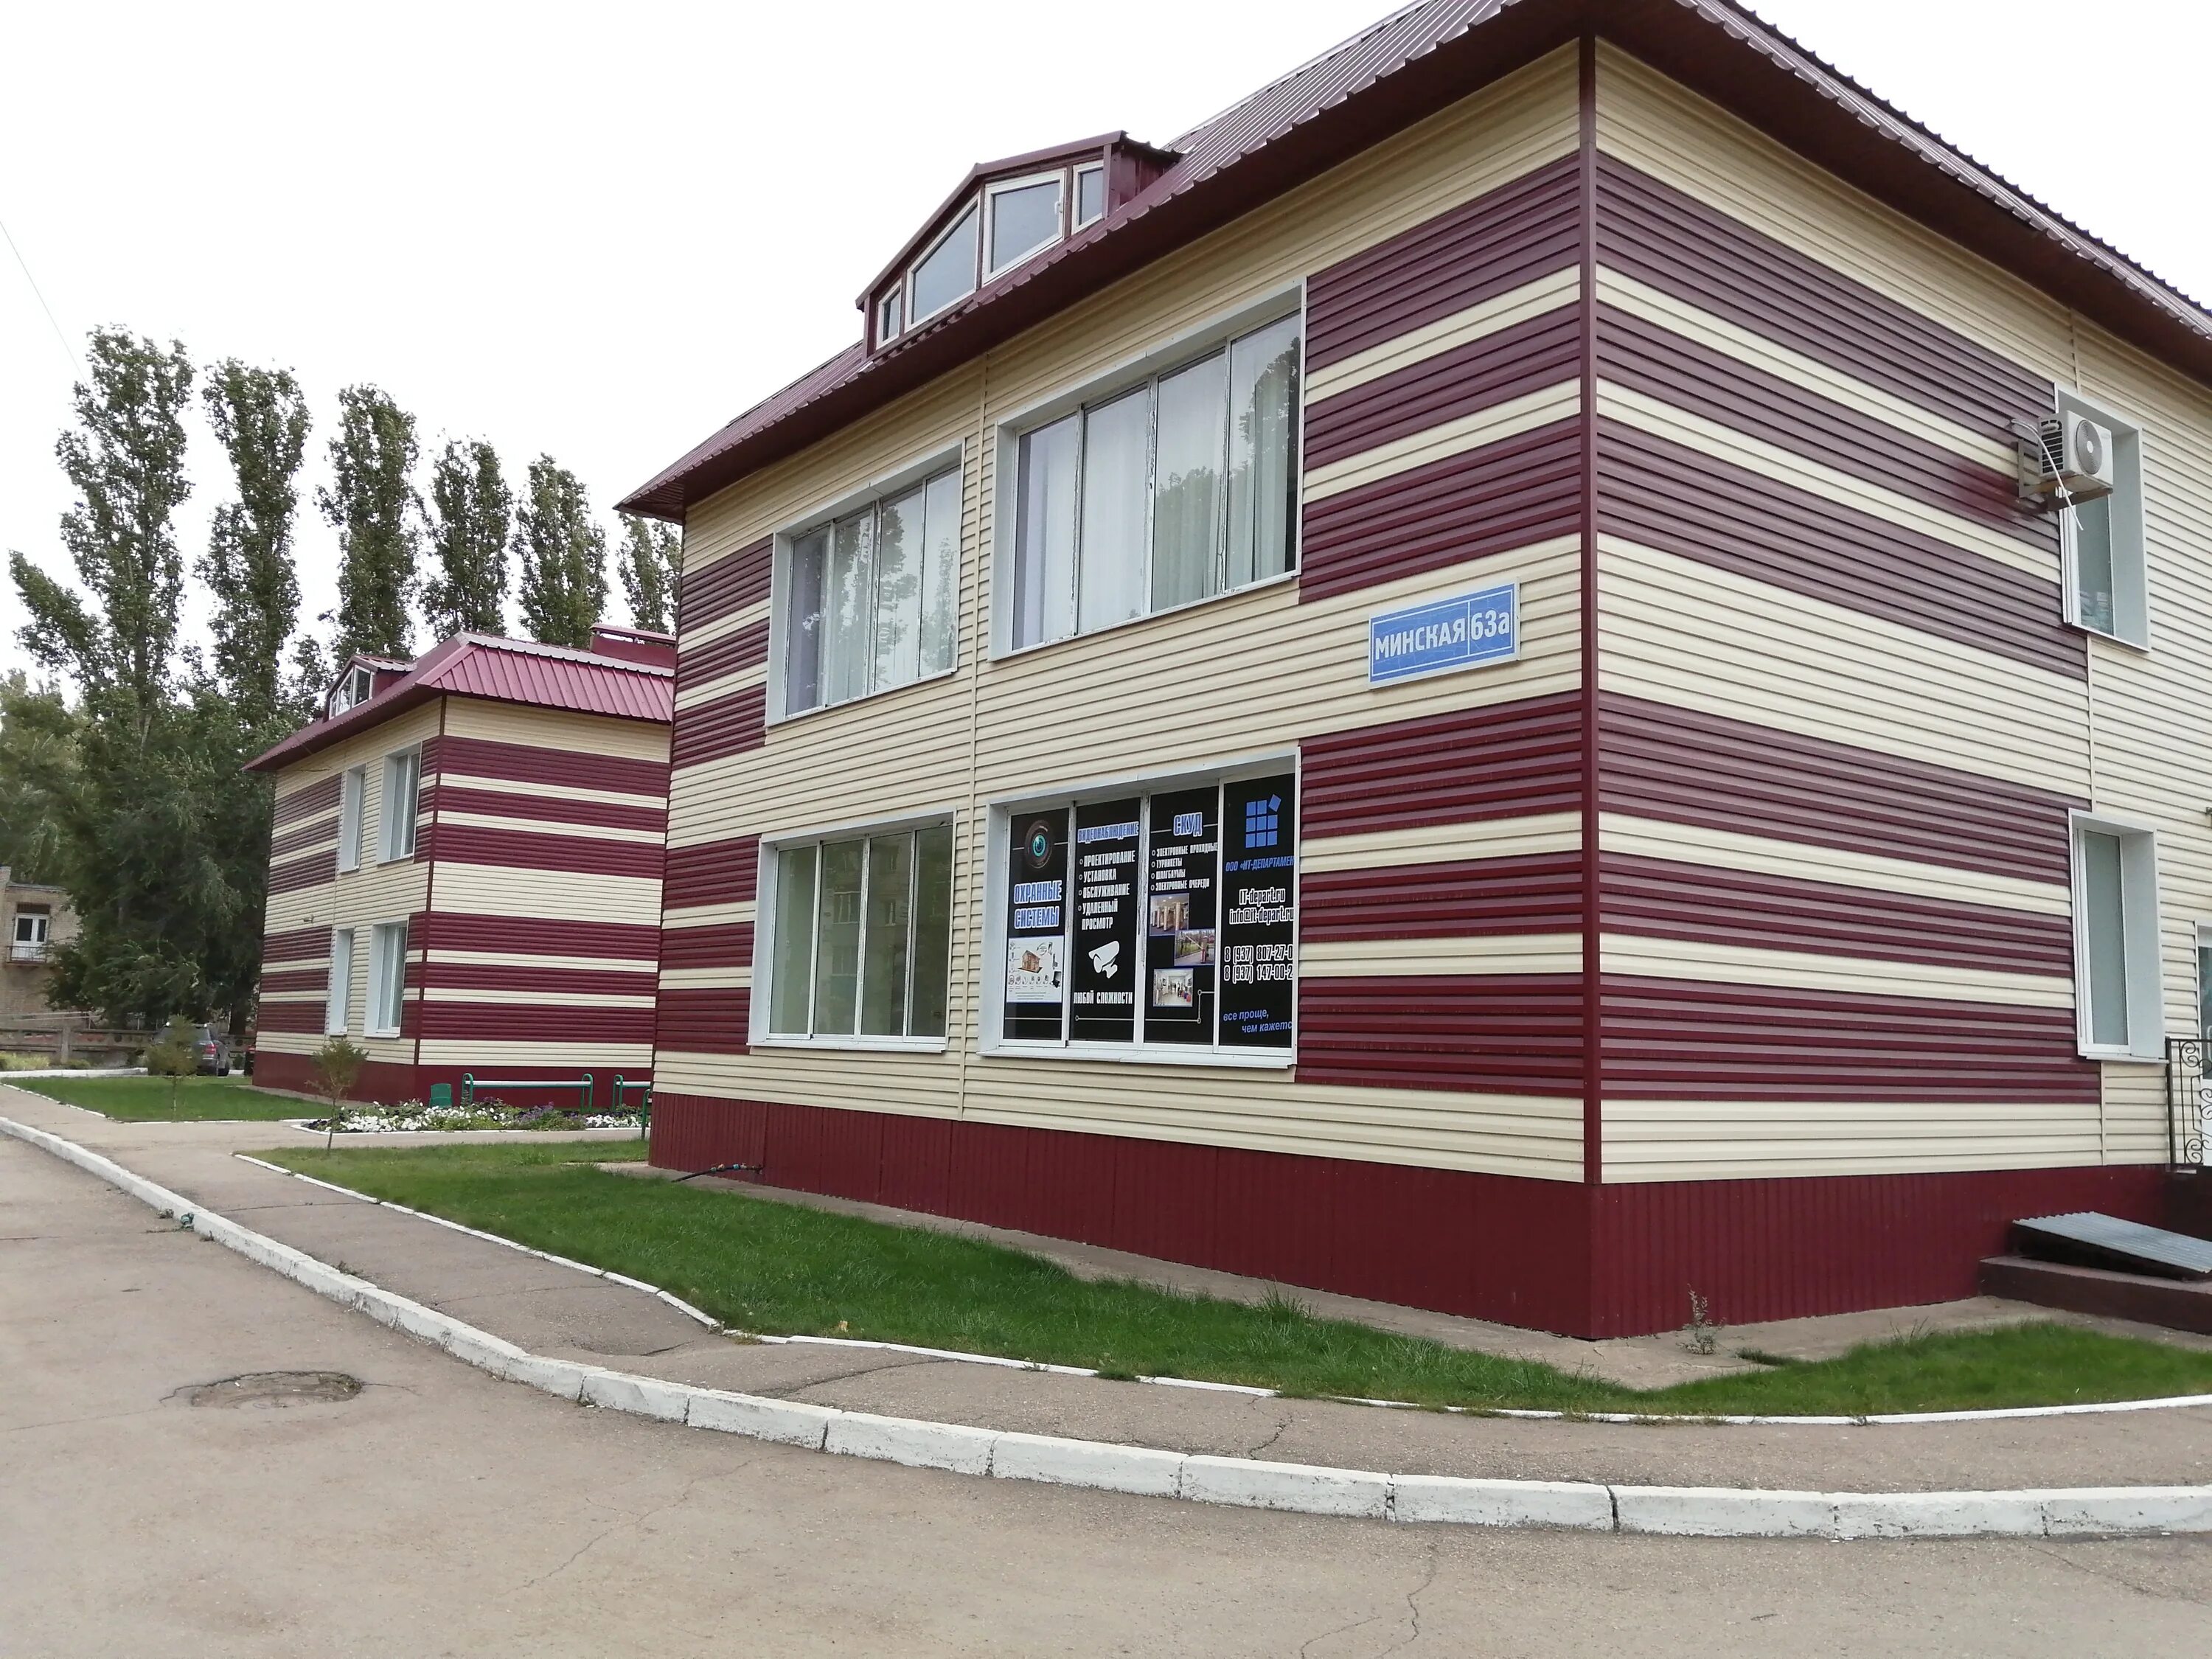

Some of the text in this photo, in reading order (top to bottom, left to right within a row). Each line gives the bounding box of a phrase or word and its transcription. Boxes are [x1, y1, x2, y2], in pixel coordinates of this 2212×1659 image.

[1375, 610, 1510, 660] МИНСКАЯ 63а
[1077, 821, 1139, 844] ВИДЕОНАБЛЮДЕНИЕ
[1173, 812, 1203, 837] СКУД
[1156, 842, 1218, 857] ЭЛЕКТРОННЫЕ ПРОХОДНЫЕ
[1084, 850, 1135, 867] ПРОЕКТИРОВАНИЕ
[1156, 858, 1183, 869] ТУРНИКЕТЫ
[1225, 861, 1239, 872] ООО
[1083, 869, 1117, 883] УСТАНОВКА
[1155, 869, 1186, 880] ШЛАГБАУМЫ
[1014, 880, 1062, 904] ОХРАННЫЕ
[1082, 883, 1130, 899] ОБСЛУЖИВАНИЕ
[1155, 878, 1210, 891] ЭЛЕКТРОННЫЕ ОЧЕРЕДИ
[1239, 887, 1286, 907] IT-depart.ru
[1082, 899, 1119, 916] УДАЛЕННЫЙ
[1229, 905, 1294, 925] info@it-depart.ru
[1014, 906, 1060, 929] СИСТЕМЫ
[1081, 917, 1113, 931] ПРОСМОТР
[1224, 946, 1231, 962] 8
[1233, 945, 1253, 964] (937)
[1223, 964, 1231, 981] 8
[1232, 964, 1253, 984] (937)
[1074, 990, 1133, 1004] ЛЮБОЙ СЛОЖНОСТИ
[1223, 1009, 1269, 1021] все проще,
[1242, 1024, 1258, 1033] чем
